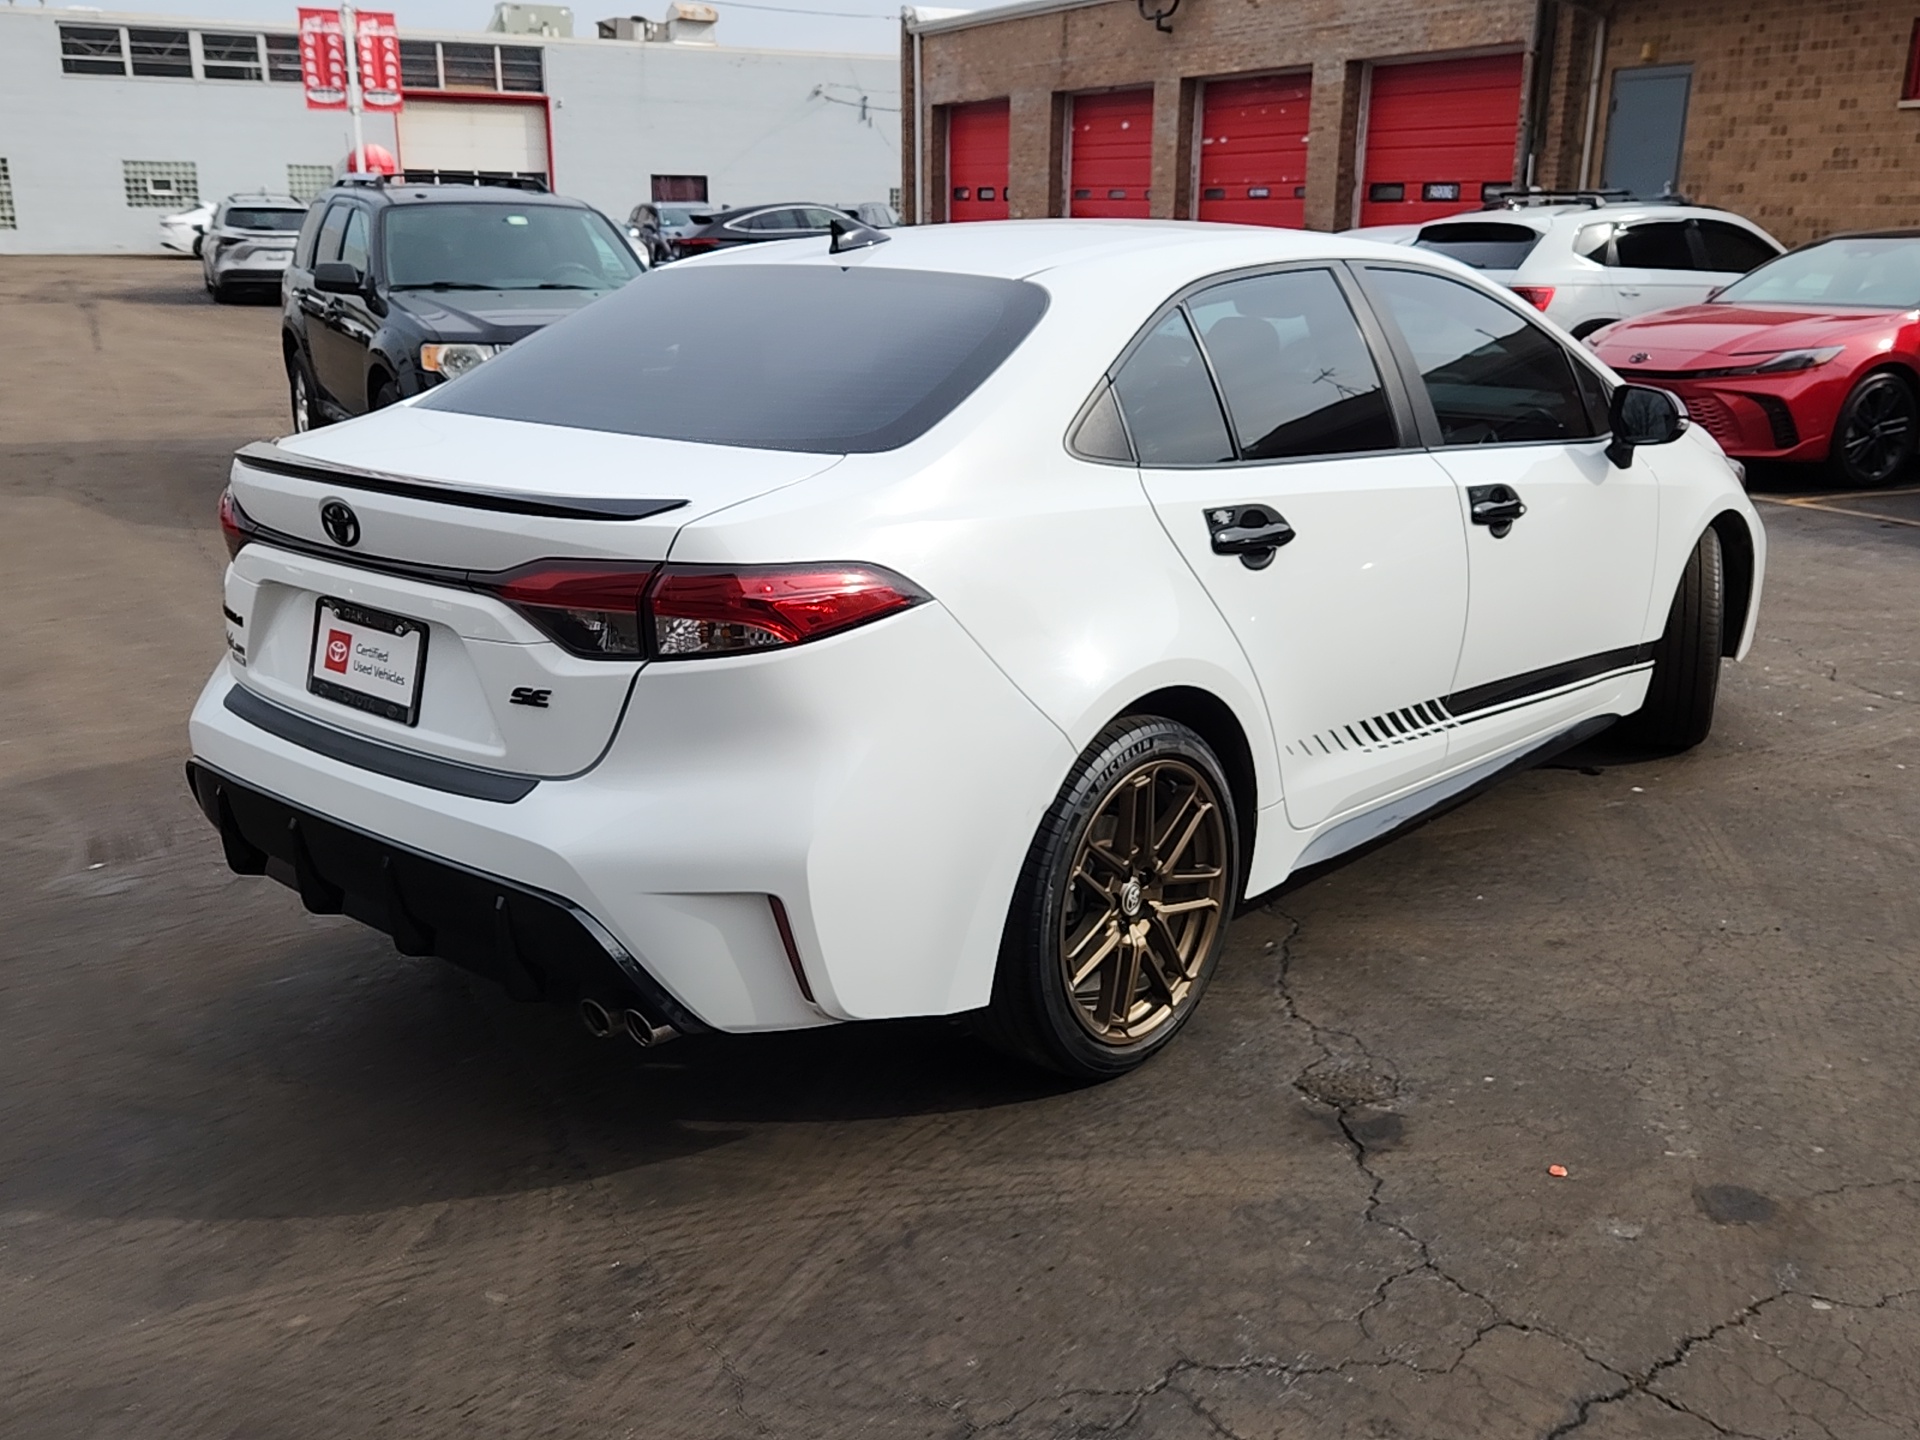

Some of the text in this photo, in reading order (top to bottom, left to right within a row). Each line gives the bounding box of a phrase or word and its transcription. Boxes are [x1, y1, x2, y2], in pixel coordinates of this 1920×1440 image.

[303, 33, 320, 88] USED
[327, 34, 342, 88] CARS
[360, 36, 376, 89] USED
[383, 37, 397, 90] CARS
[353, 660, 405, 686] Used Vehicles
[356, 643, 389, 662] Certified
[509, 687, 552, 708] SE
[1094, 739, 1152, 791] MICHELIN
